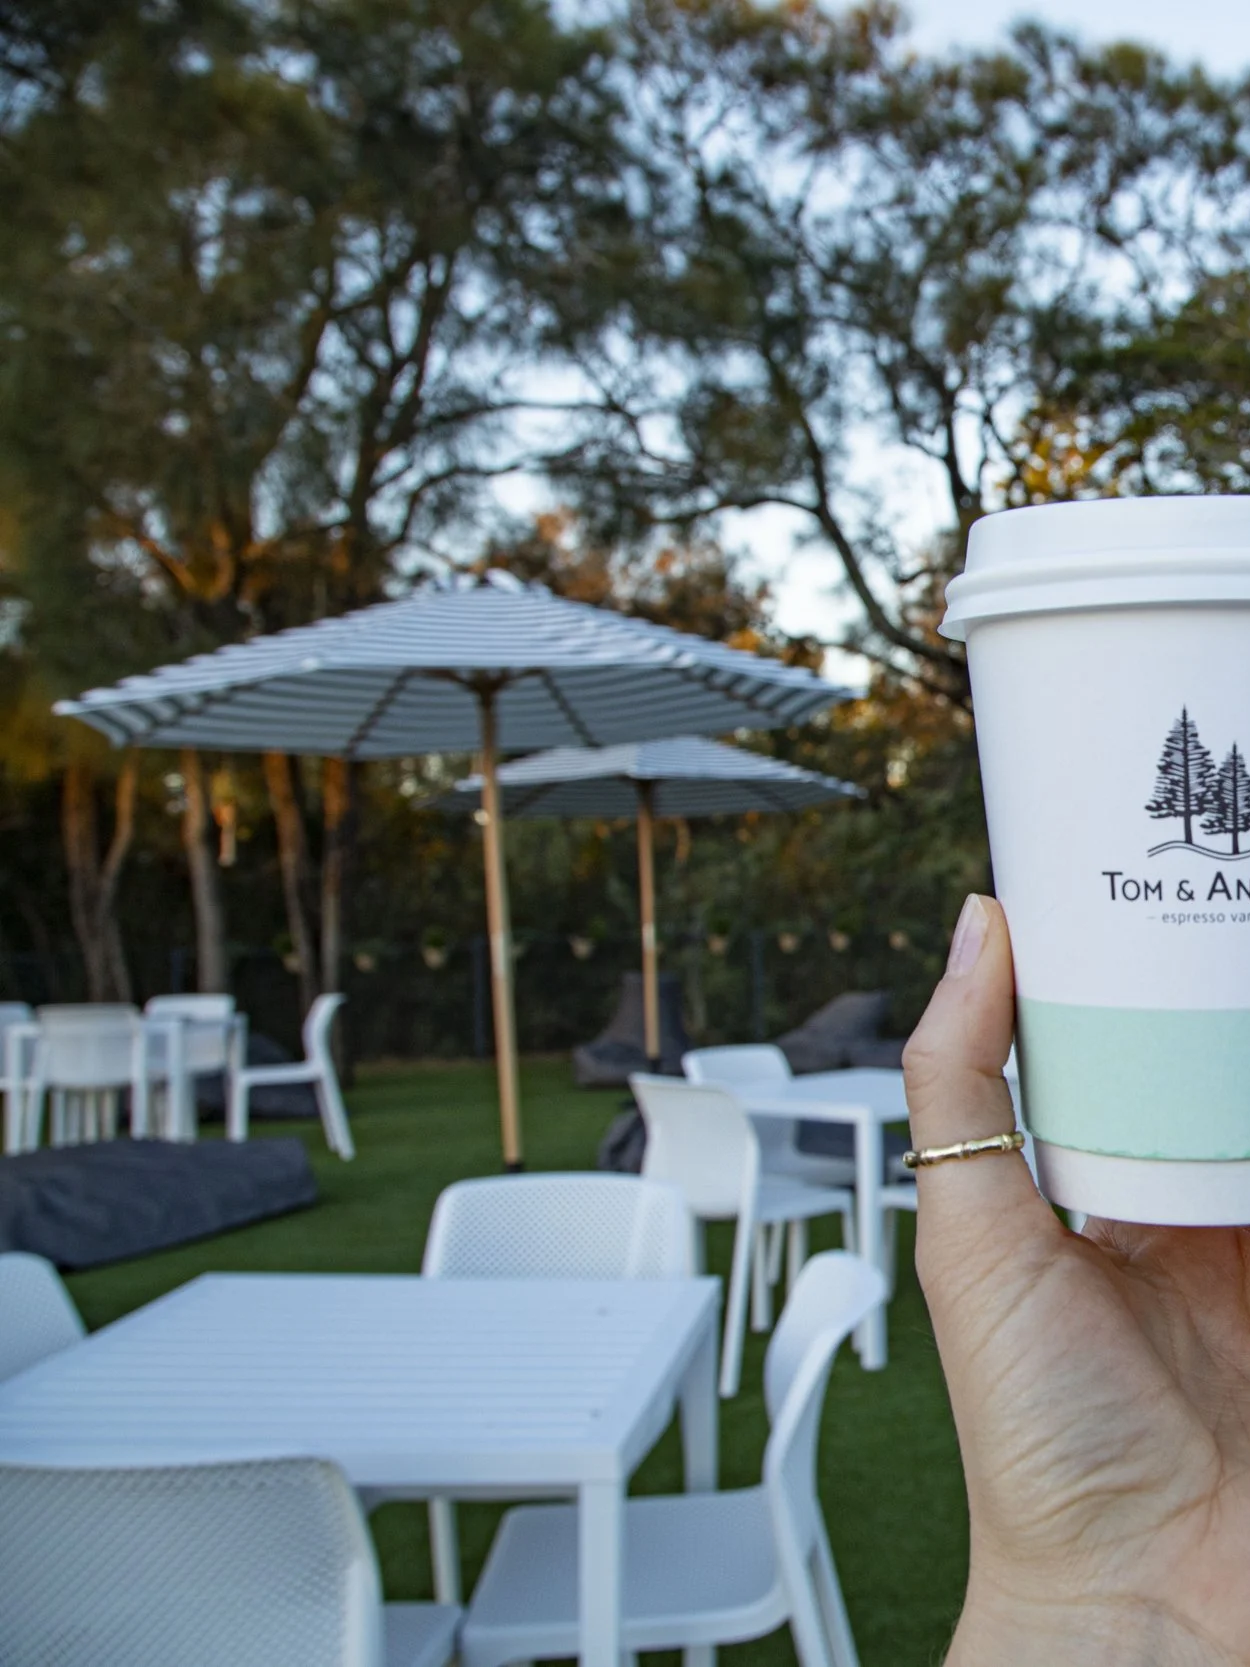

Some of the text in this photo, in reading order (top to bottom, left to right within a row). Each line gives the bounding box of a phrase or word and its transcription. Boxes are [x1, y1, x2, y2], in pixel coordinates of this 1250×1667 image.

[1101, 871, 1163, 901] TOM
[1176, 879, 1196, 901] &
[1161, 912, 1226, 925] espresso
